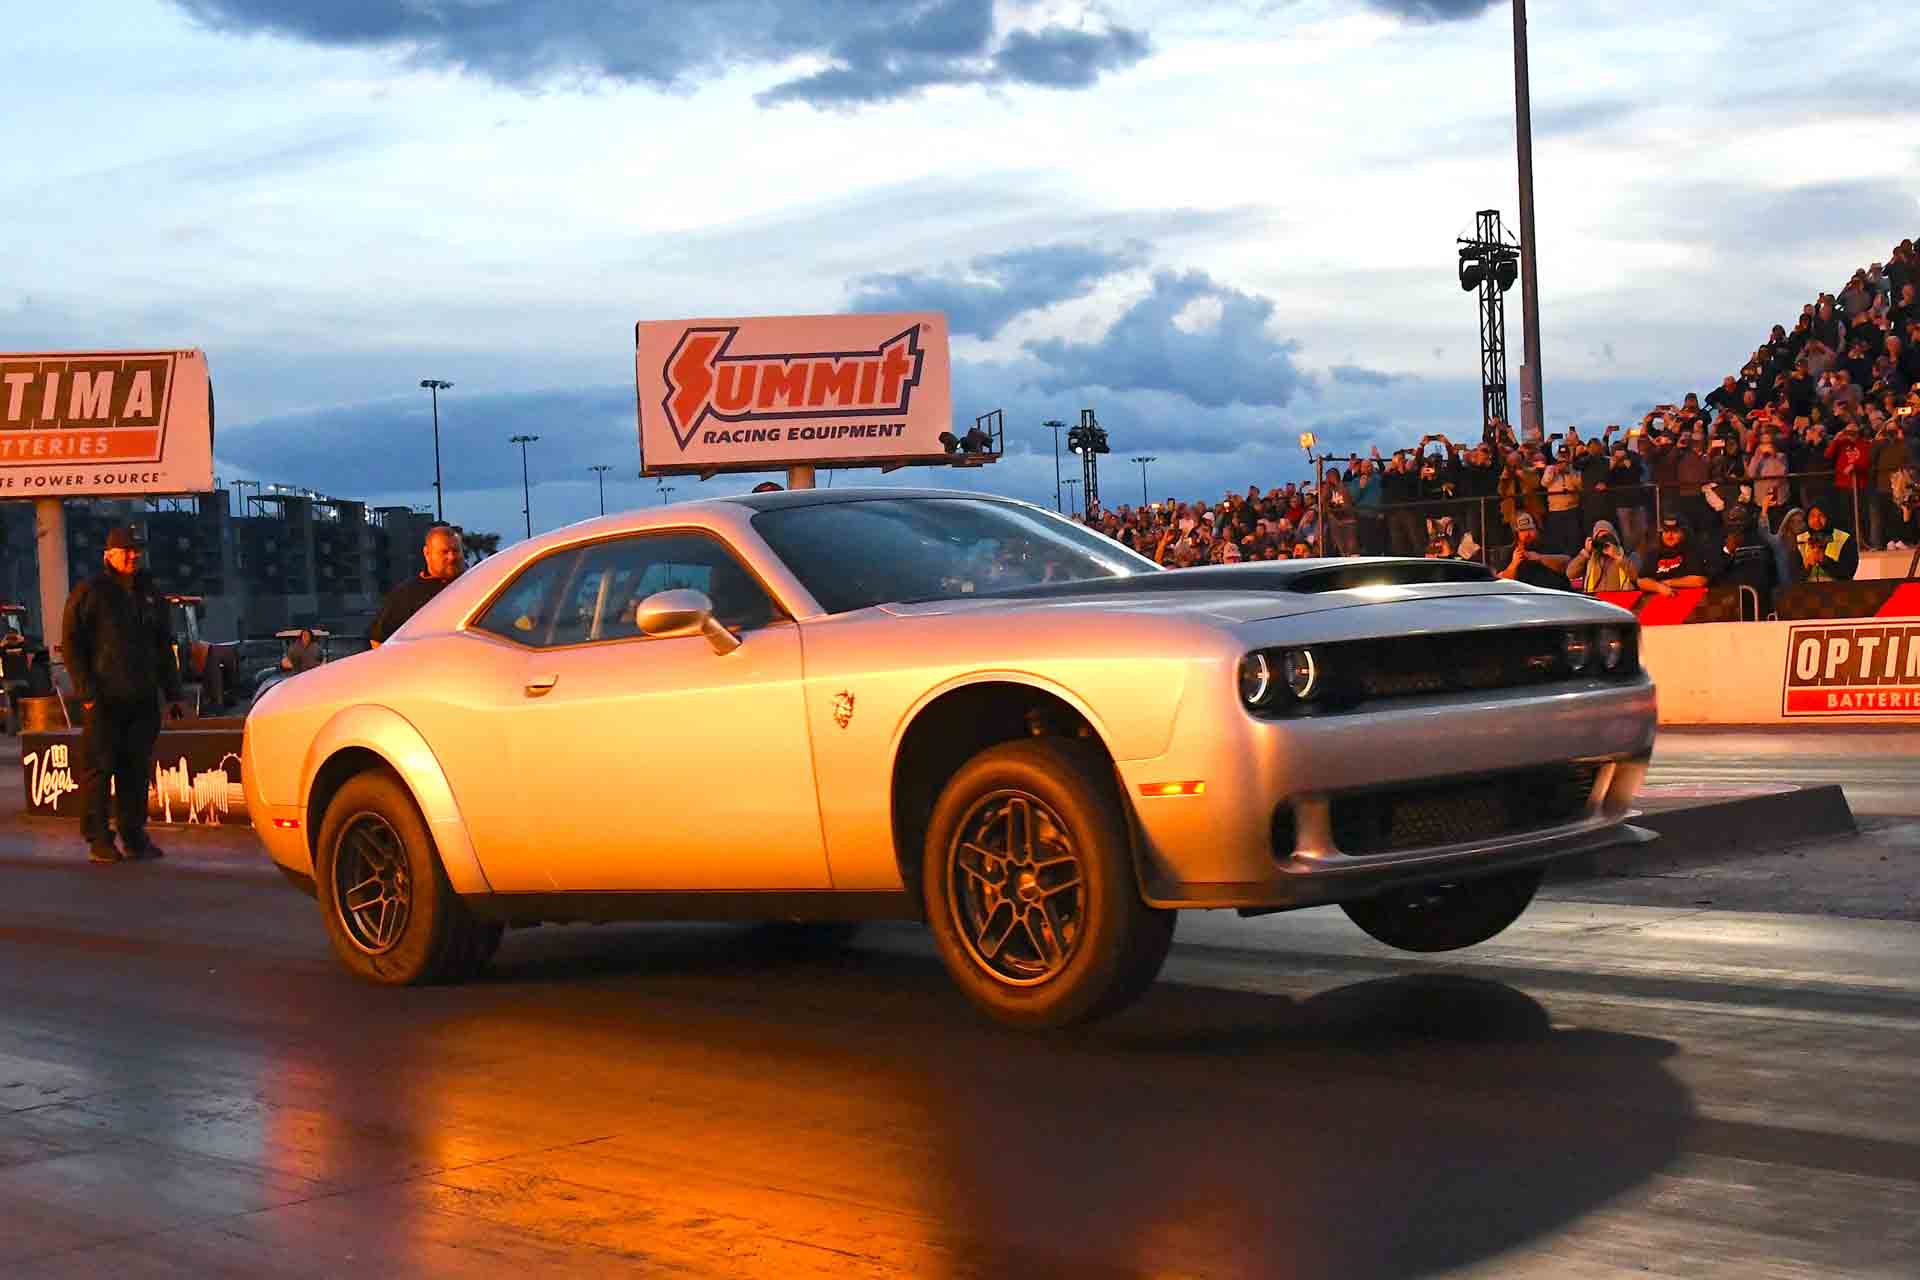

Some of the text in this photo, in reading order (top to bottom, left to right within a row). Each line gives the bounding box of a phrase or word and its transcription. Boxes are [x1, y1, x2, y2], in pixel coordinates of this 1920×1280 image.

[3, 370, 153, 421] TIMA
[703, 423, 906, 444] RACING EQUIPMENT
[0, 436, 109, 457] TTERIES
[24, 475, 84, 487] POWER
[93, 472, 160, 485] SOURCE
[1827, 693, 1920, 708] BATTERIE
[23, 749, 79, 810] Vegas
